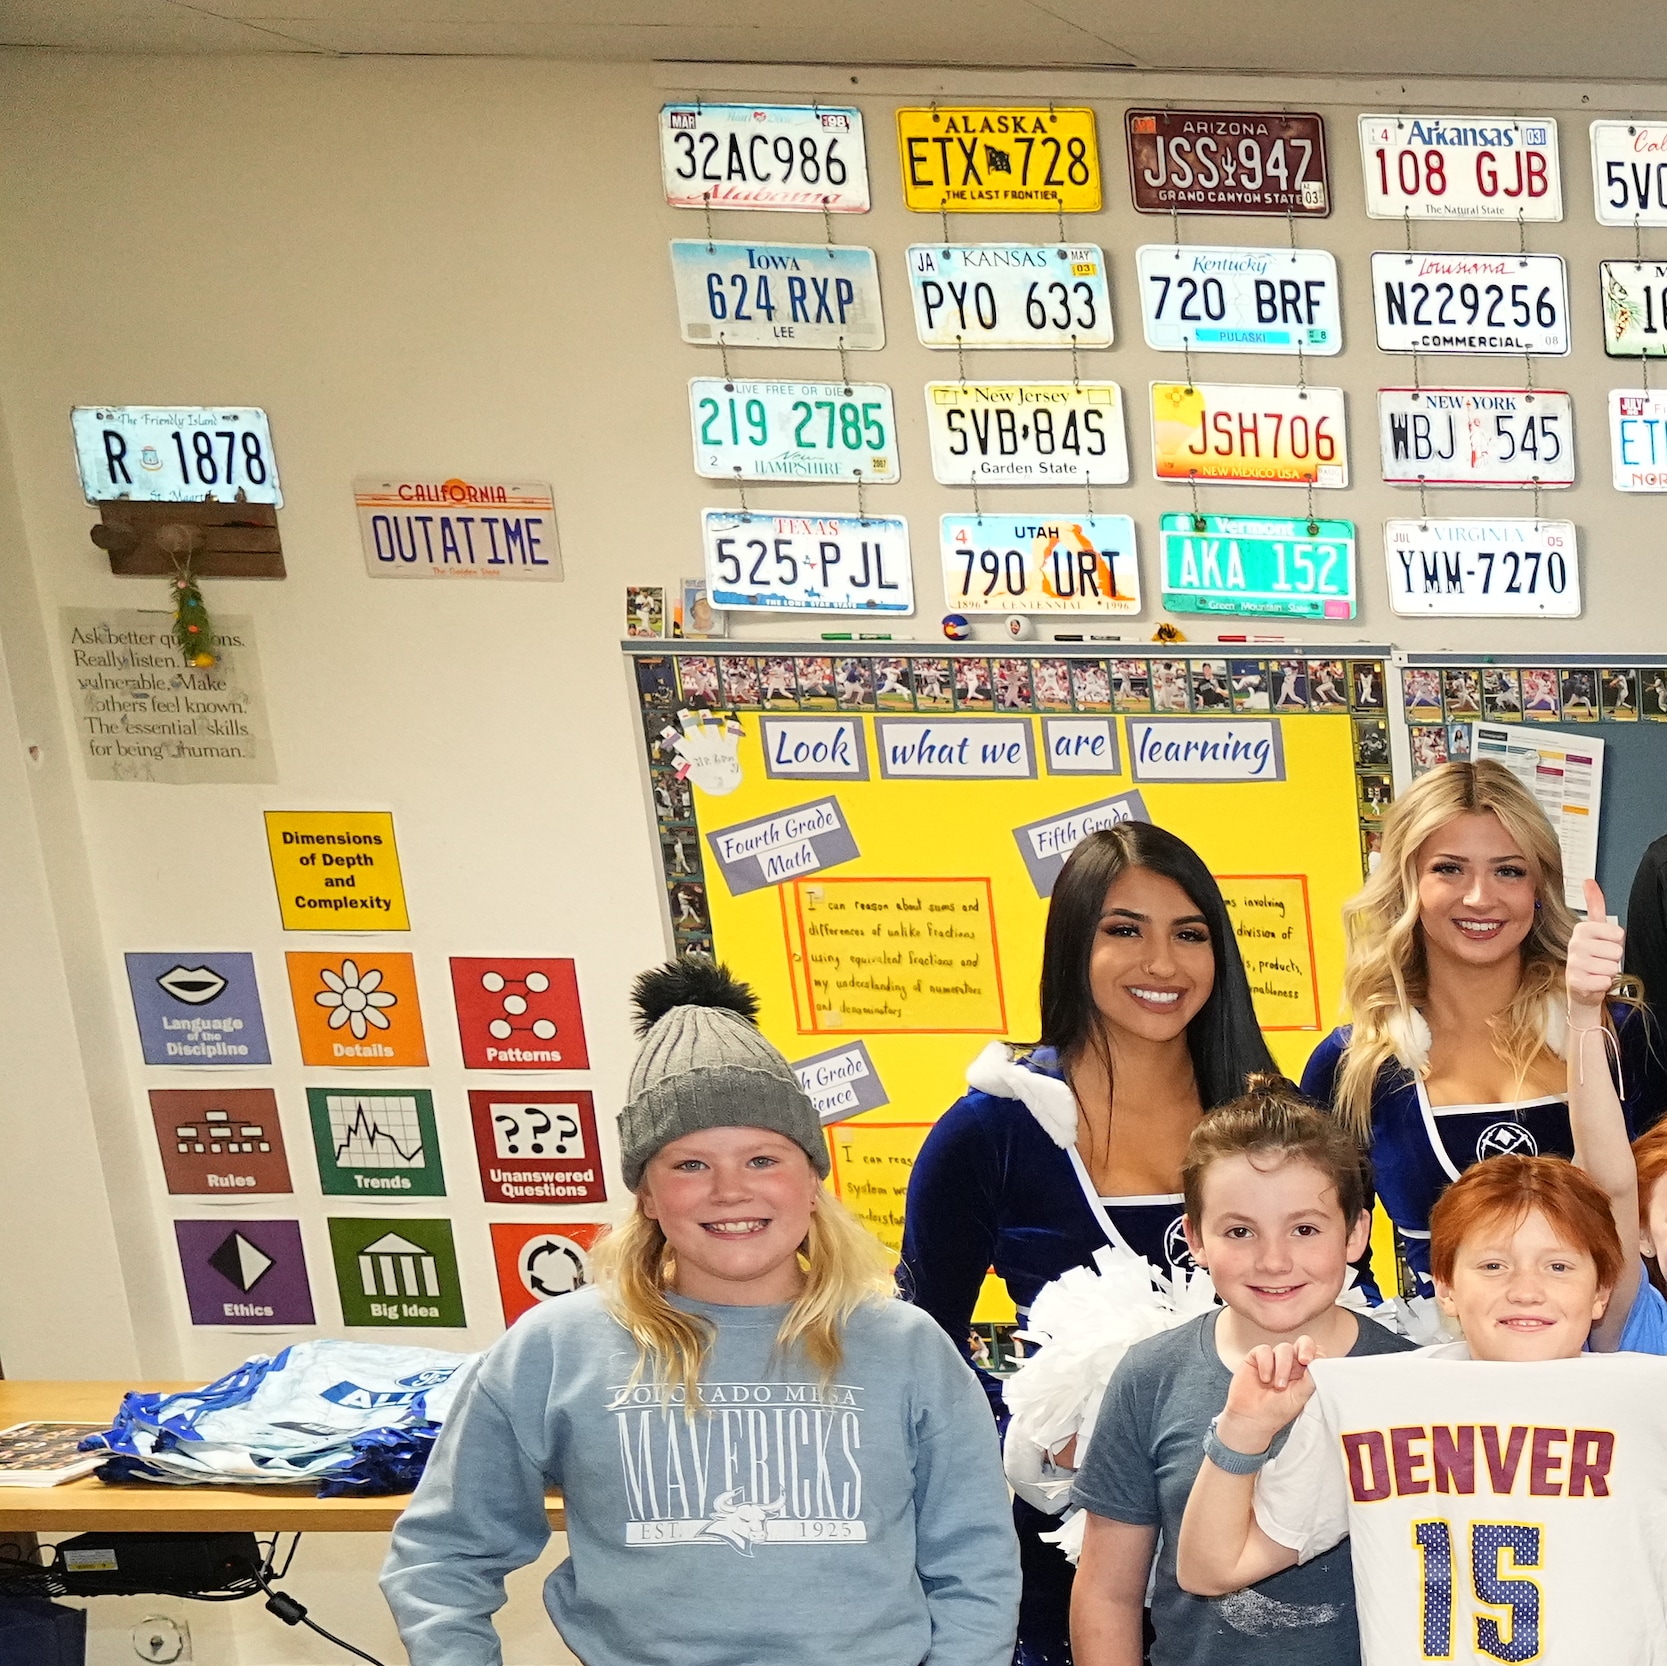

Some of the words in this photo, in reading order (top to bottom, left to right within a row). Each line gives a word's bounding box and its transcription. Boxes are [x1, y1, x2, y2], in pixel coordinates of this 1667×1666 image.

[945, 116, 1049, 134] ALASKA
[1182, 122, 1269, 136] ARIZONA
[674, 132, 847, 186] 32AC986
[910, 138, 983, 187] ETX
[1020, 138, 1090, 185] 728
[1144, 138, 1222, 188] JSS
[1242, 139, 1313, 190] 947
[1376, 150, 1447, 196] 108
[1475, 151, 1549, 198] GJB
[1158, 190, 1202, 202] GRAND
[1207, 192, 1261, 203] CANYON
[1265, 193, 1303, 204] STATE
[962, 251, 1048, 268] KANSAS
[708, 272, 775, 322] 624
[789, 278, 853, 325] RXP
[1151, 278, 1224, 321] 720
[1257, 281, 1326, 325] BRF
[1387, 282, 1556, 330] N229256
[736, 385, 761, 395] LIVE
[767, 385, 795, 395] FREE
[801, 386, 819, 395] OR
[824, 386, 845, 396] DIE
[1426, 396, 1466, 410] NEW
[1473, 396, 1517, 410] YORK
[700, 398, 766, 446] 219
[793, 401, 884, 452] 2785
[1390, 414, 1456, 462] WBJ
[1496, 415, 1560, 463] 545
[172, 431, 266, 485] 1878
[398, 484, 508, 504] CALIFORNIA
[775, 517, 839, 536] TEXAS
[1015, 526, 1059, 540] UTAH
[372, 515, 548, 566] OUTATIME
[717, 539, 798, 586] 525
[820, 542, 898, 591] PJL
[956, 550, 1025, 596] 790
[1050, 550, 1120, 596] URT
[1179, 539, 1245, 590] AKA
[1273, 546, 1337, 593] 152
[72, 628, 101, 645] Ask
[107, 628, 154, 645] better
[74, 650, 125, 670] Really
[131, 649, 180, 668] listen.
[96, 696, 147, 713] others
[151, 697, 180, 713] feel
[186, 696, 247, 714] known.
[775, 726, 852, 765] Look
[890, 735, 969, 765] what
[981, 737, 1022, 764] we
[1055, 731, 1105, 756] are
[1139, 726, 1272, 775] learning
[282, 832, 383, 847] Dimensions
[724, 825, 782, 858] Fourth
[785, 808, 836, 838] Grade
[300, 853, 317, 866] of
[321, 854, 373, 870] Depth
[766, 845, 814, 876] Math
[325, 875, 356, 887] and
[295, 896, 392, 913] Complexity
[806, 891, 816, 910] I
[828, 902, 845, 910] can
[855, 901, 888, 911] reason
[897, 898, 922, 911] about
[929, 902, 955, 911] sums
[963, 899, 979, 911] and
[162, 1016, 243, 1034] Language
[188, 1032, 200, 1040] of
[202, 1032, 221, 1040] the
[167, 1042, 249, 1059] Discipline
[333, 1044, 394, 1058] Details
[486, 1047, 562, 1063] Patterns
[207, 1174, 256, 1189] Rules
[354, 1175, 412, 1190] Trends
[490, 1168, 594, 1184] Unanswered
[501, 1182, 588, 1198] Questions
[224, 1303, 274, 1318] Ethics
[371, 1304, 398, 1320] Big
[402, 1304, 440, 1318] Idea
[618, 1406, 864, 1522] MAVERICKS
[1341, 1422, 1616, 1504] DENVER
[798, 1521, 853, 1538] 1925
